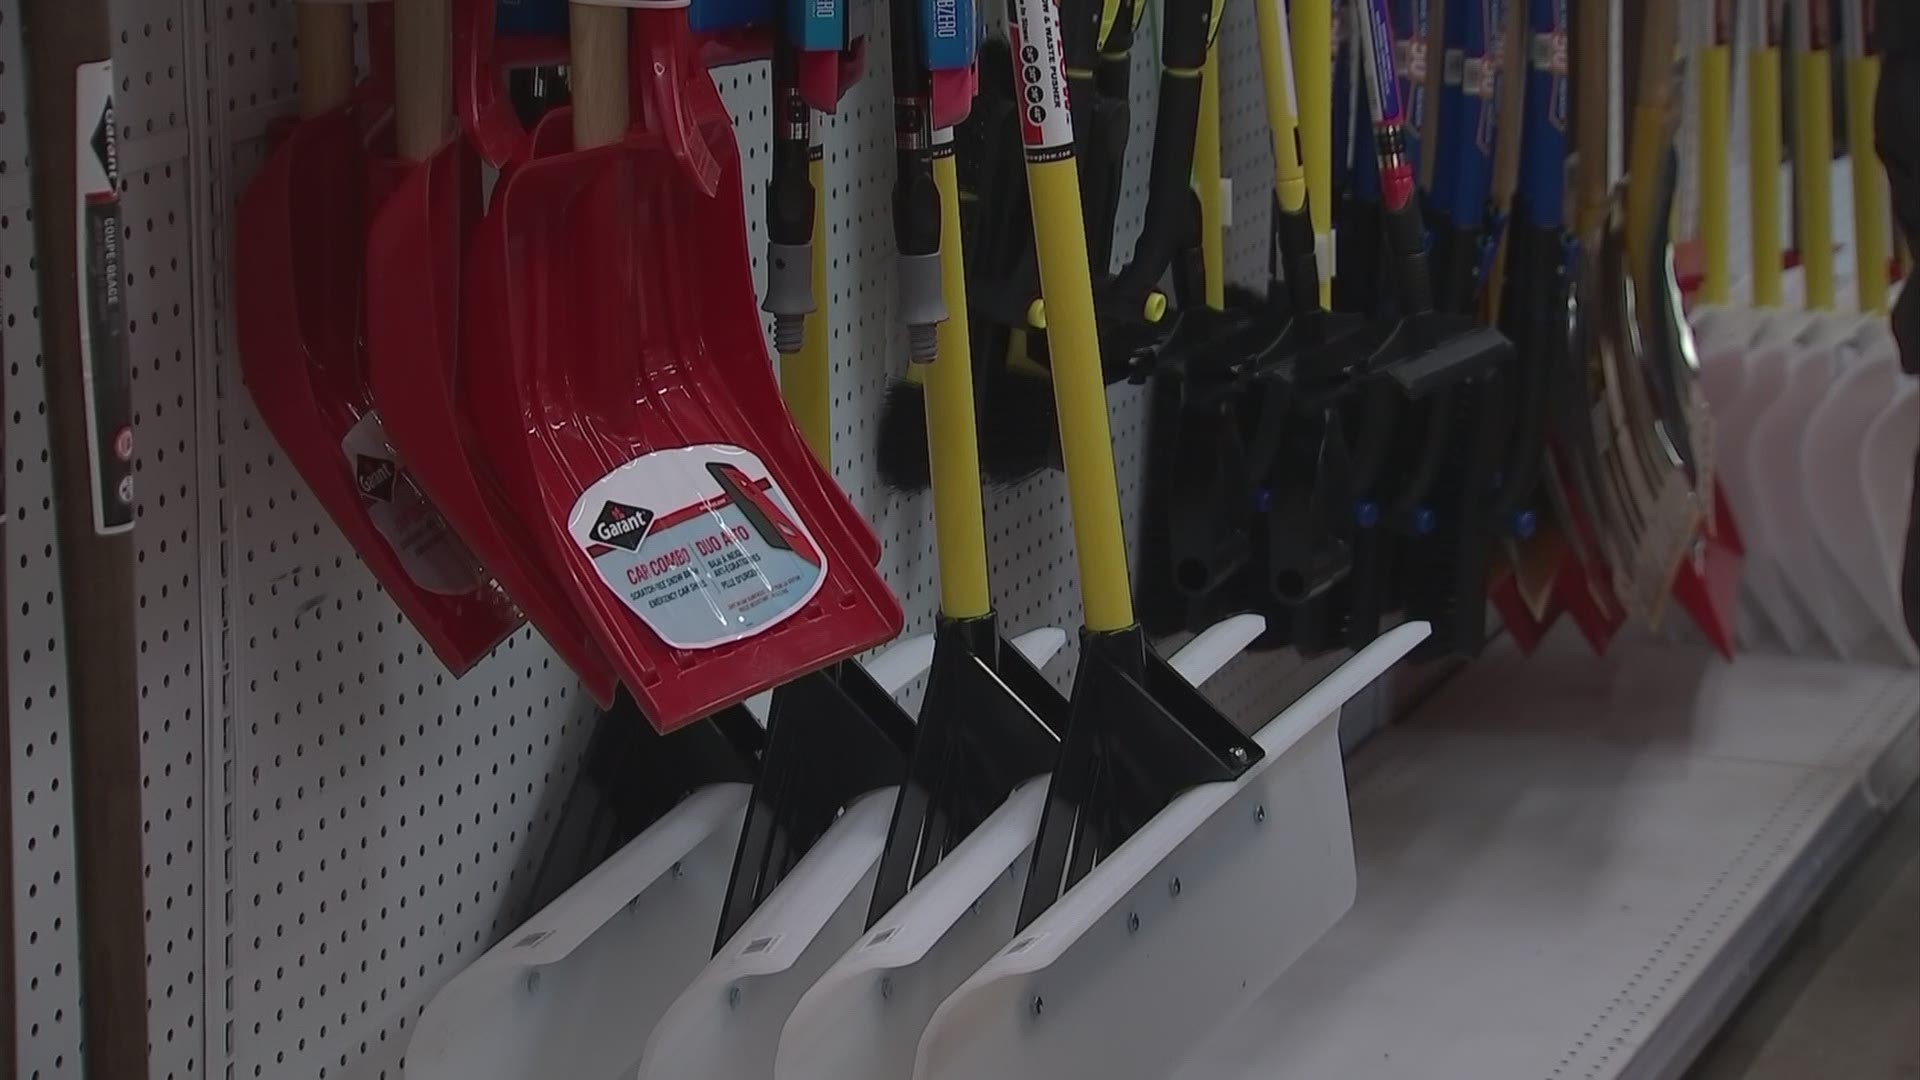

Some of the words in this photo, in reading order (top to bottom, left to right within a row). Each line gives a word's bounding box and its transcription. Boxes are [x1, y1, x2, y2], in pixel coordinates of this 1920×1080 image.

[1043, 16, 1051, 24] &
[1045, 27, 1056, 64] WASTE
[1050, 66, 1061, 108] PUSHER
[359, 463, 392, 493] Garant
[597, 510, 646, 541] Garant
[695, 535, 722, 557] DUO
[649, 547, 691, 576] COMBO
